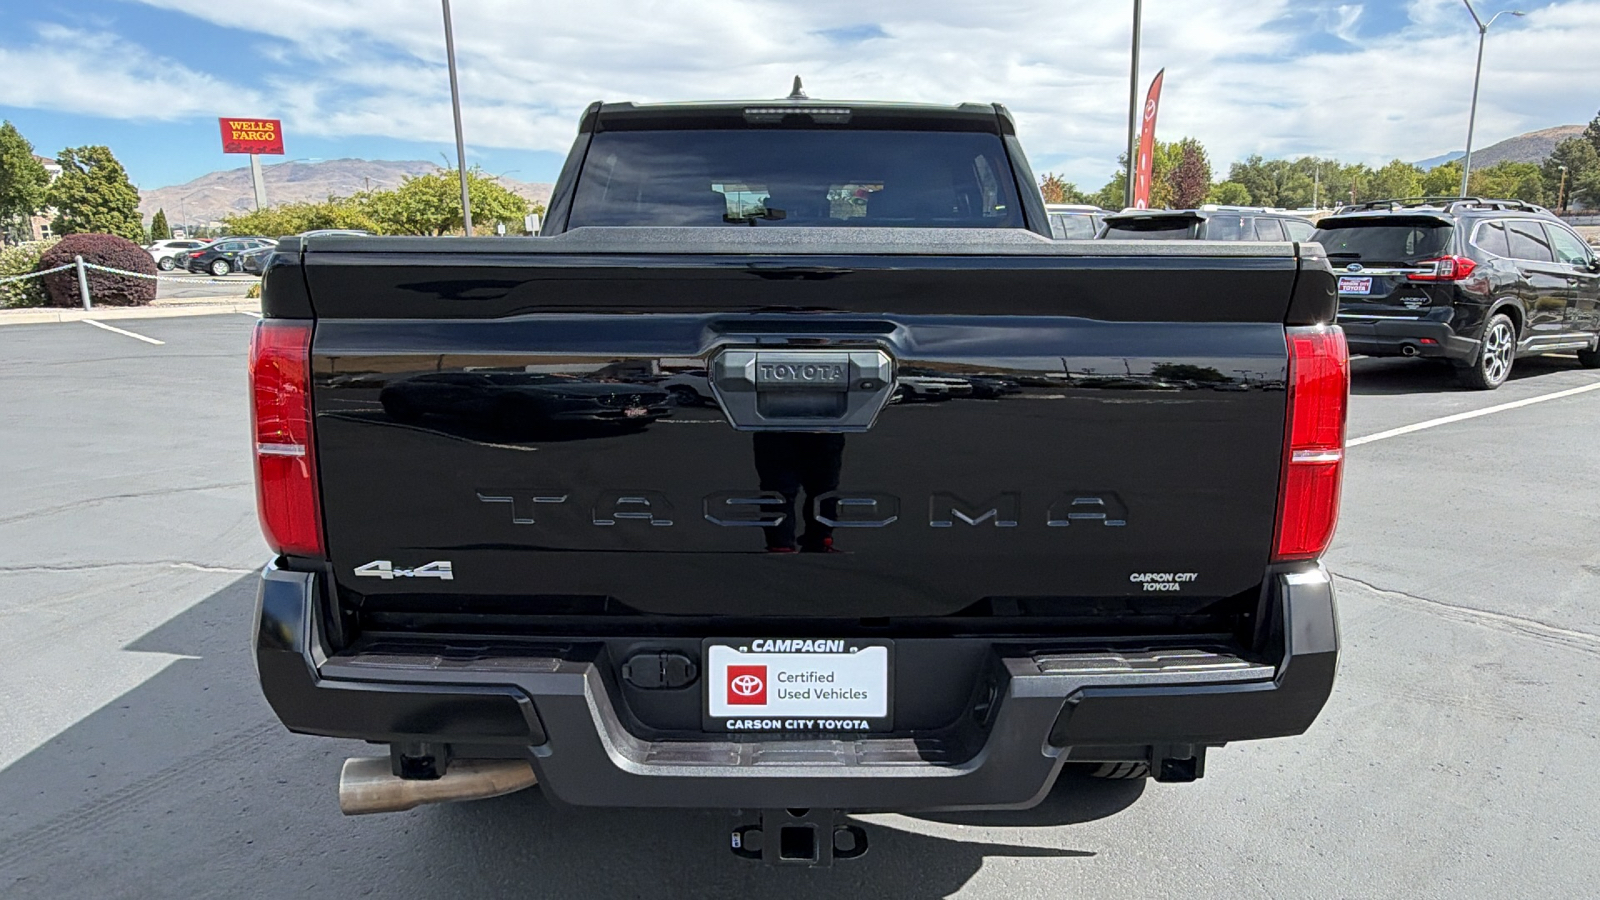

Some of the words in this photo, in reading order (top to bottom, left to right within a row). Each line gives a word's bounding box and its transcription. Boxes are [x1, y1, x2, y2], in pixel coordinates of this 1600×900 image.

[228, 121, 274, 131] WELLS
[232, 131, 275, 141] FARGO
[761, 365, 844, 380] TOYOTA
[476, 488, 1128, 527] TACOMA
[353, 560, 454, 580] 4x4
[1129, 573, 1173, 582] CARSON
[1175, 573, 1198, 582] CITY
[1143, 583, 1180, 591] TOYOTA
[751, 639, 845, 653] CAMPAGNI
[777, 671, 835, 683] Certified
[777, 688, 811, 700] Used
[814, 688, 868, 700] Vehicles
[726, 719, 782, 730] CARSON
[784, 719, 814, 730] CITY
[816, 720, 870, 730] TOYOTA
